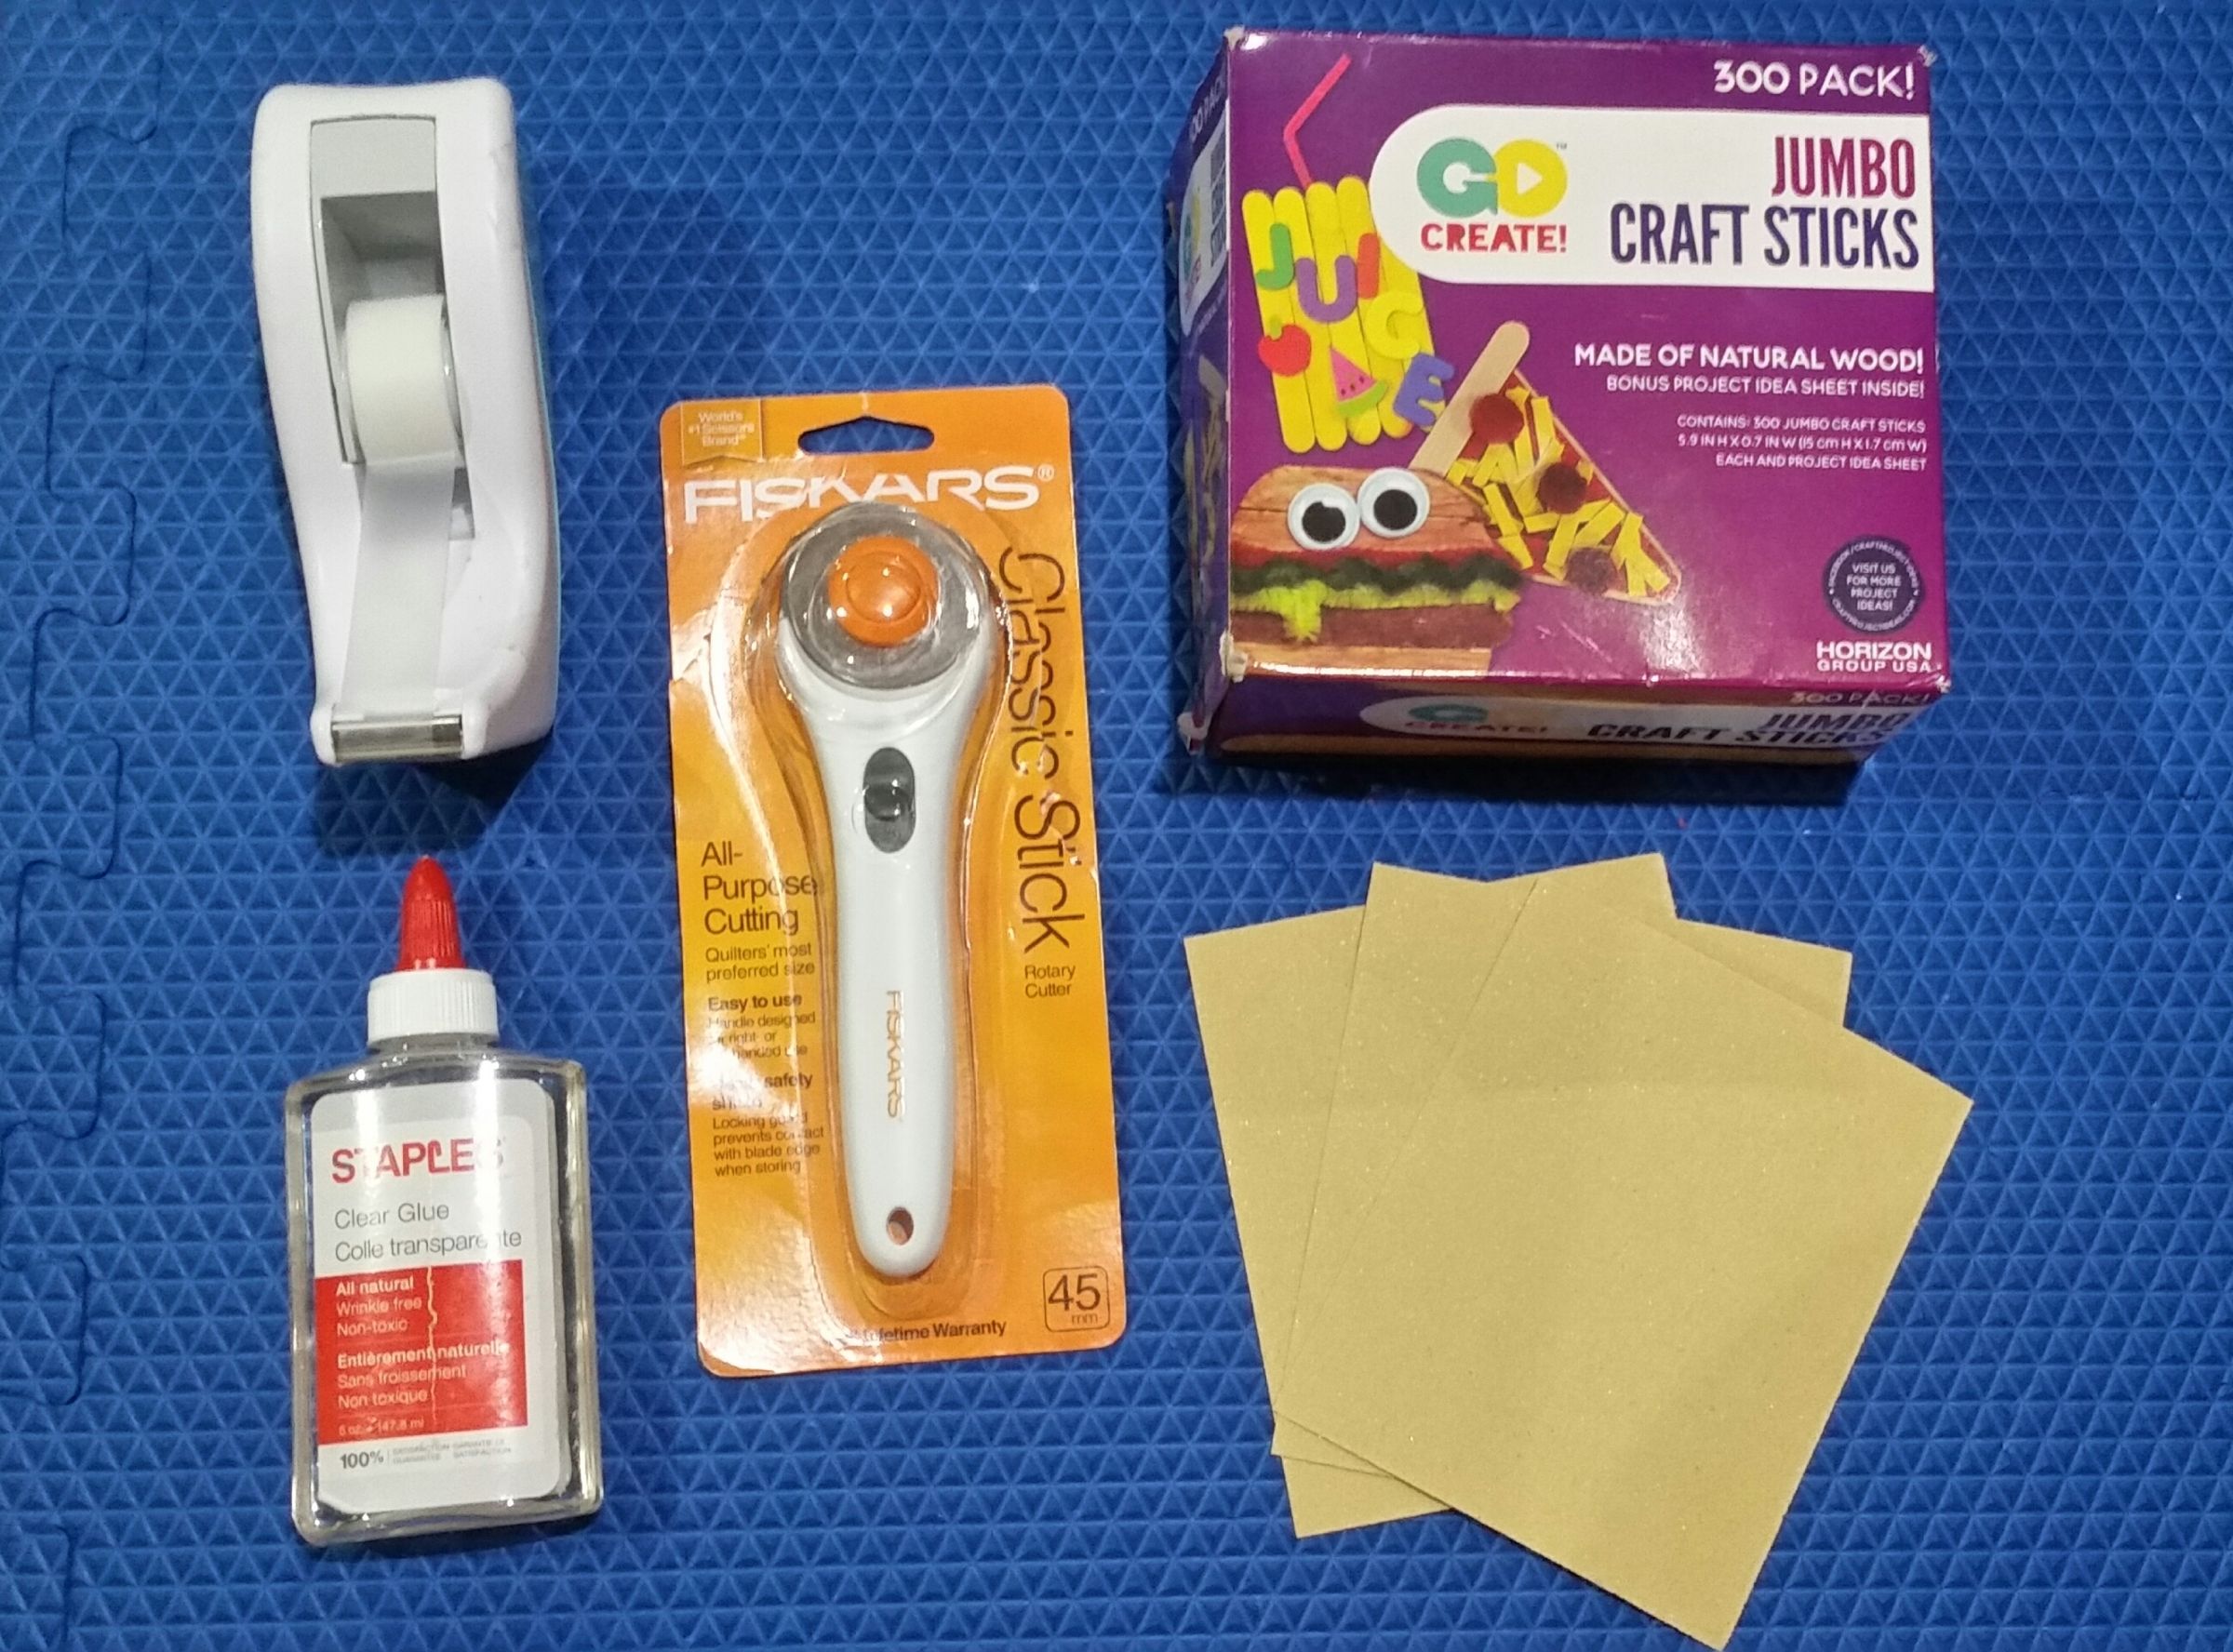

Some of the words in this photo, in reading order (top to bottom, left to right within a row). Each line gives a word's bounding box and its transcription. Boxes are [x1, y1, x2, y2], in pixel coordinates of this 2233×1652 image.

[1714, 60, 1790, 93] 300
[1799, 62, 1915, 100] PACK!
[1772, 136, 1916, 201] JUMBO
[1420, 223, 1569, 253] CREATE!
[1611, 201, 1749, 265] CRAFT
[1763, 205, 1920, 271] STICKS
[1574, 343, 1651, 367] MADE
[1658, 344, 1694, 367] OF
[1700, 345, 1825, 371] NATURAL
[1829, 348, 1925, 374] WOOD!
[1607, 374, 1670, 393] BONUS
[1674, 375, 1750, 394] PROJECT
[1756, 377, 1798, 395] IDEA
[1801, 378, 1858, 397] SHEET
[1862, 380, 1925, 399] INSIDE!
[1783, 417, 1829, 432] JUMBO
[1831, 418, 1876, 433] CRAFT
[1879, 420, 1926, 434] STICKS
[1701, 434, 1715, 447] IN
[1718, 434, 1728, 447] H
[1765, 436, 1779, 449] IN
[1781, 437, 1797, 450] W
[1841, 440, 1852, 452] H
[1716, 453, 1755, 467] EACH
[1757, 455, 1786, 468] AND
[1788, 455, 1846, 470] PROJECT
[1849, 457, 1880, 470] IDEA
[1883, 457, 1927, 472] SHEET
[1852, 564, 1878, 574] VISIT
[1880, 564, 1896, 574] US
[1846, 575, 1867, 586] FOR
[1870, 576, 1902, 587] MORE
[1851, 587, 1898, 599] PROJECT
[1816, 640, 1932, 660] HORIZON
[998, 546, 1074, 780] Classic
[1817, 659, 1886, 673] GROUP
[1892, 660, 1932, 673] USA
[1789, 691, 1843, 704] 300
[1759, 713, 1909, 732] JUMBO
[1587, 724, 1730, 741] CRAFT
[1734, 730, 1893, 745] STICKS
[701, 840, 743, 867] All-
[1014, 794, 1085, 954] Stick
[702, 873, 819, 904] Purpose
[704, 906, 799, 937] Cutting
[705, 943, 770, 964] Quilters'
[773, 941, 812, 958] most
[706, 962, 779, 984] preferred
[784, 962, 816, 977] size
[1024, 964, 1076, 984] Rotary
[1025, 982, 1072, 1000] Cutter
[708, 996, 748, 1014] Easy
[752, 995, 769, 1008] to
[772, 993, 803, 1007] use
[757, 1011, 816, 1029] designed
[764, 1031, 777, 1043] or
[765, 1072, 814, 1091] safety
[713, 1115, 765, 1131] Locking
[714, 1129, 772, 1146] prevents
[715, 1146, 742, 1161] with
[745, 1144, 782, 1159] blade
[786, 1144, 821, 1158] edge
[715, 1163, 752, 1177] when
[755, 1159, 801, 1175] storing
[335, 1208, 390, 1229] Clear
[397, 1201, 449, 1223] Glue
[335, 1240, 383, 1262] Colle
[336, 1281, 356, 1297] All
[359, 1275, 415, 1294] natural
[1046, 1272, 1101, 1312] 45
[337, 1299, 389, 1317] Wrinkle
[393, 1296, 422, 1312] free
[337, 1318, 408, 1338] Non-toxic
[932, 1320, 1007, 1338] Warranty
[1071, 1312, 1099, 1326] mm
[338, 1372, 373, 1390] Sans
[378, 1365, 467, 1385] froissement
[338, 1394, 371, 1409] Non
[373, 1389, 429, 1407] toxique
[340, 1448, 384, 1470] 100%
